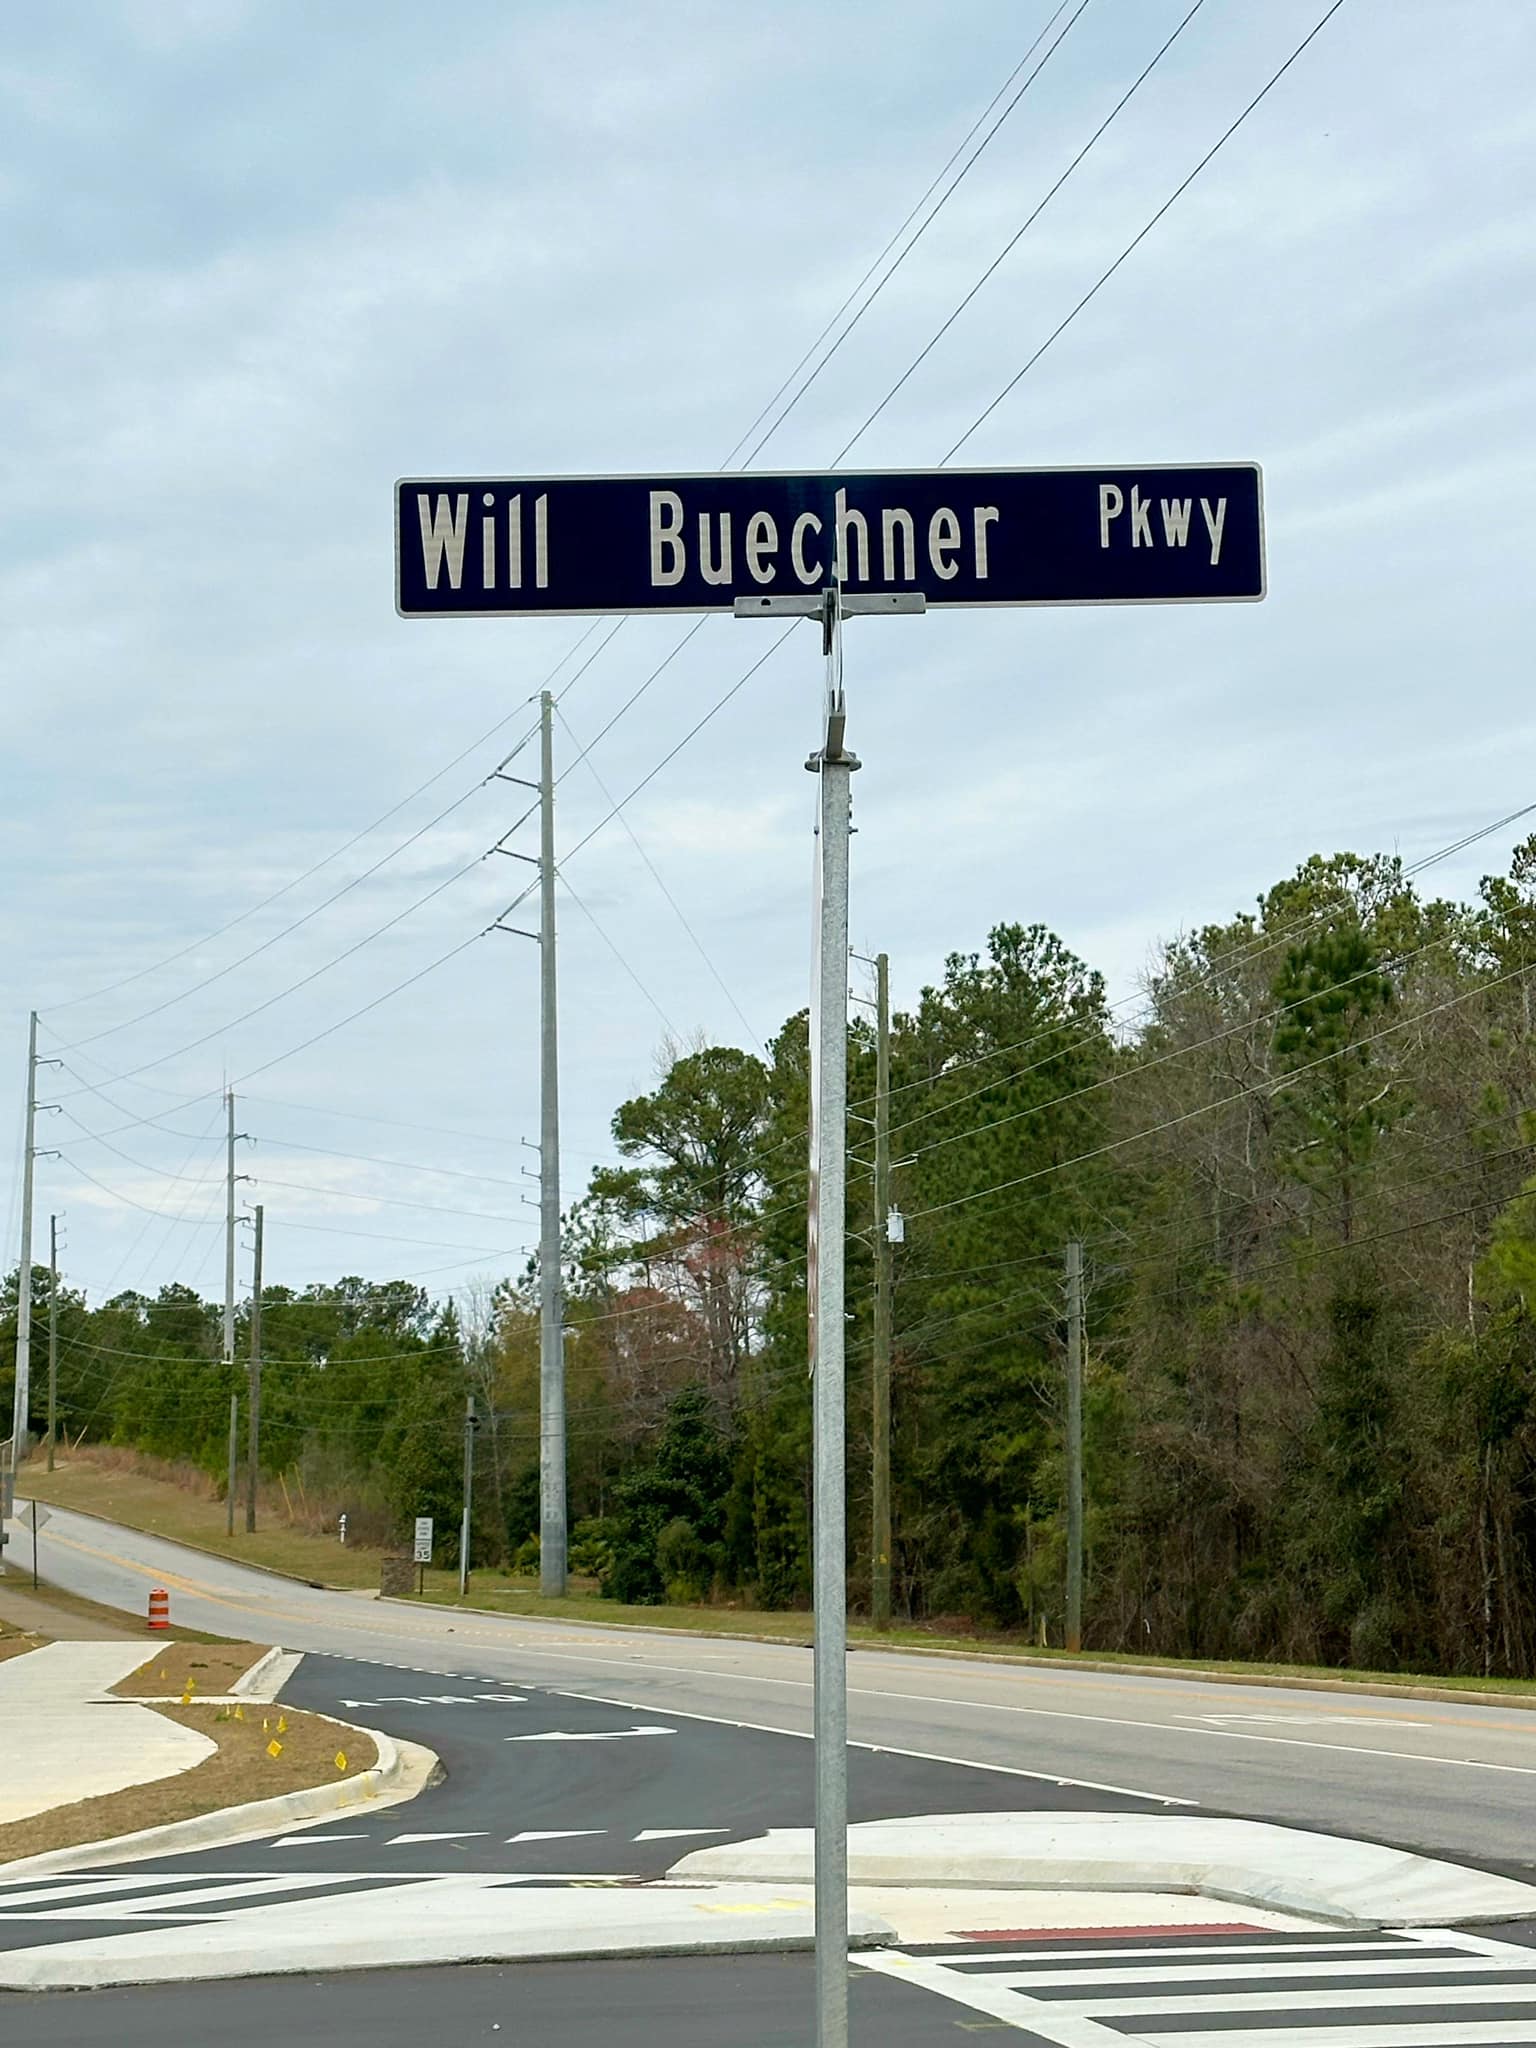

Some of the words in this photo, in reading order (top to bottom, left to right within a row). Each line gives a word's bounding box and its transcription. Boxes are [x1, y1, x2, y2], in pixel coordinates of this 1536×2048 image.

[416, 492, 549, 590] Will
[649, 487, 1000, 588] Buechner
[1098, 483, 1228, 566] Pkwy
[415, 1550, 430, 1560] 35
[338, 1693, 529, 1708] ONLY
